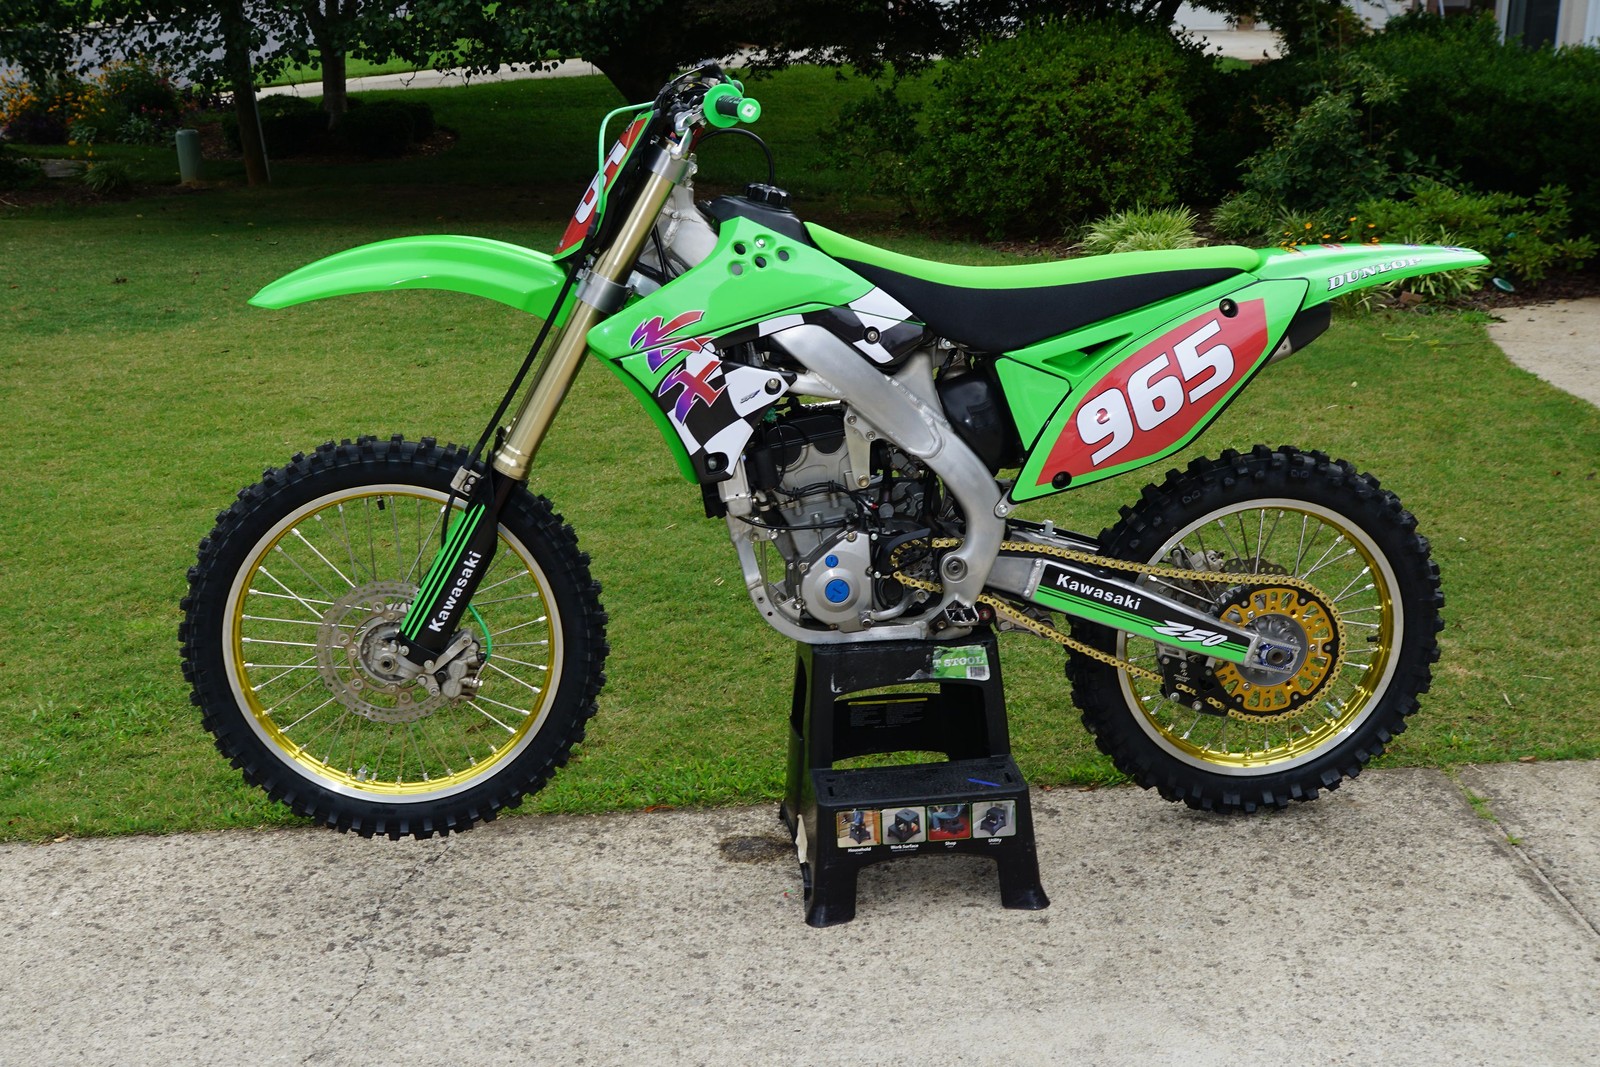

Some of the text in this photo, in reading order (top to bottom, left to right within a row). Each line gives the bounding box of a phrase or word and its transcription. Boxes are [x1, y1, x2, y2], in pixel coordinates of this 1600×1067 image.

[1327, 256, 1422, 292] DUNLOP
[1076, 318, 1235, 467] 965
[428, 550, 482, 633] Kawasaki
[1056, 573, 1141, 611] Kawasaki
[943, 656, 984, 668] STOOL
